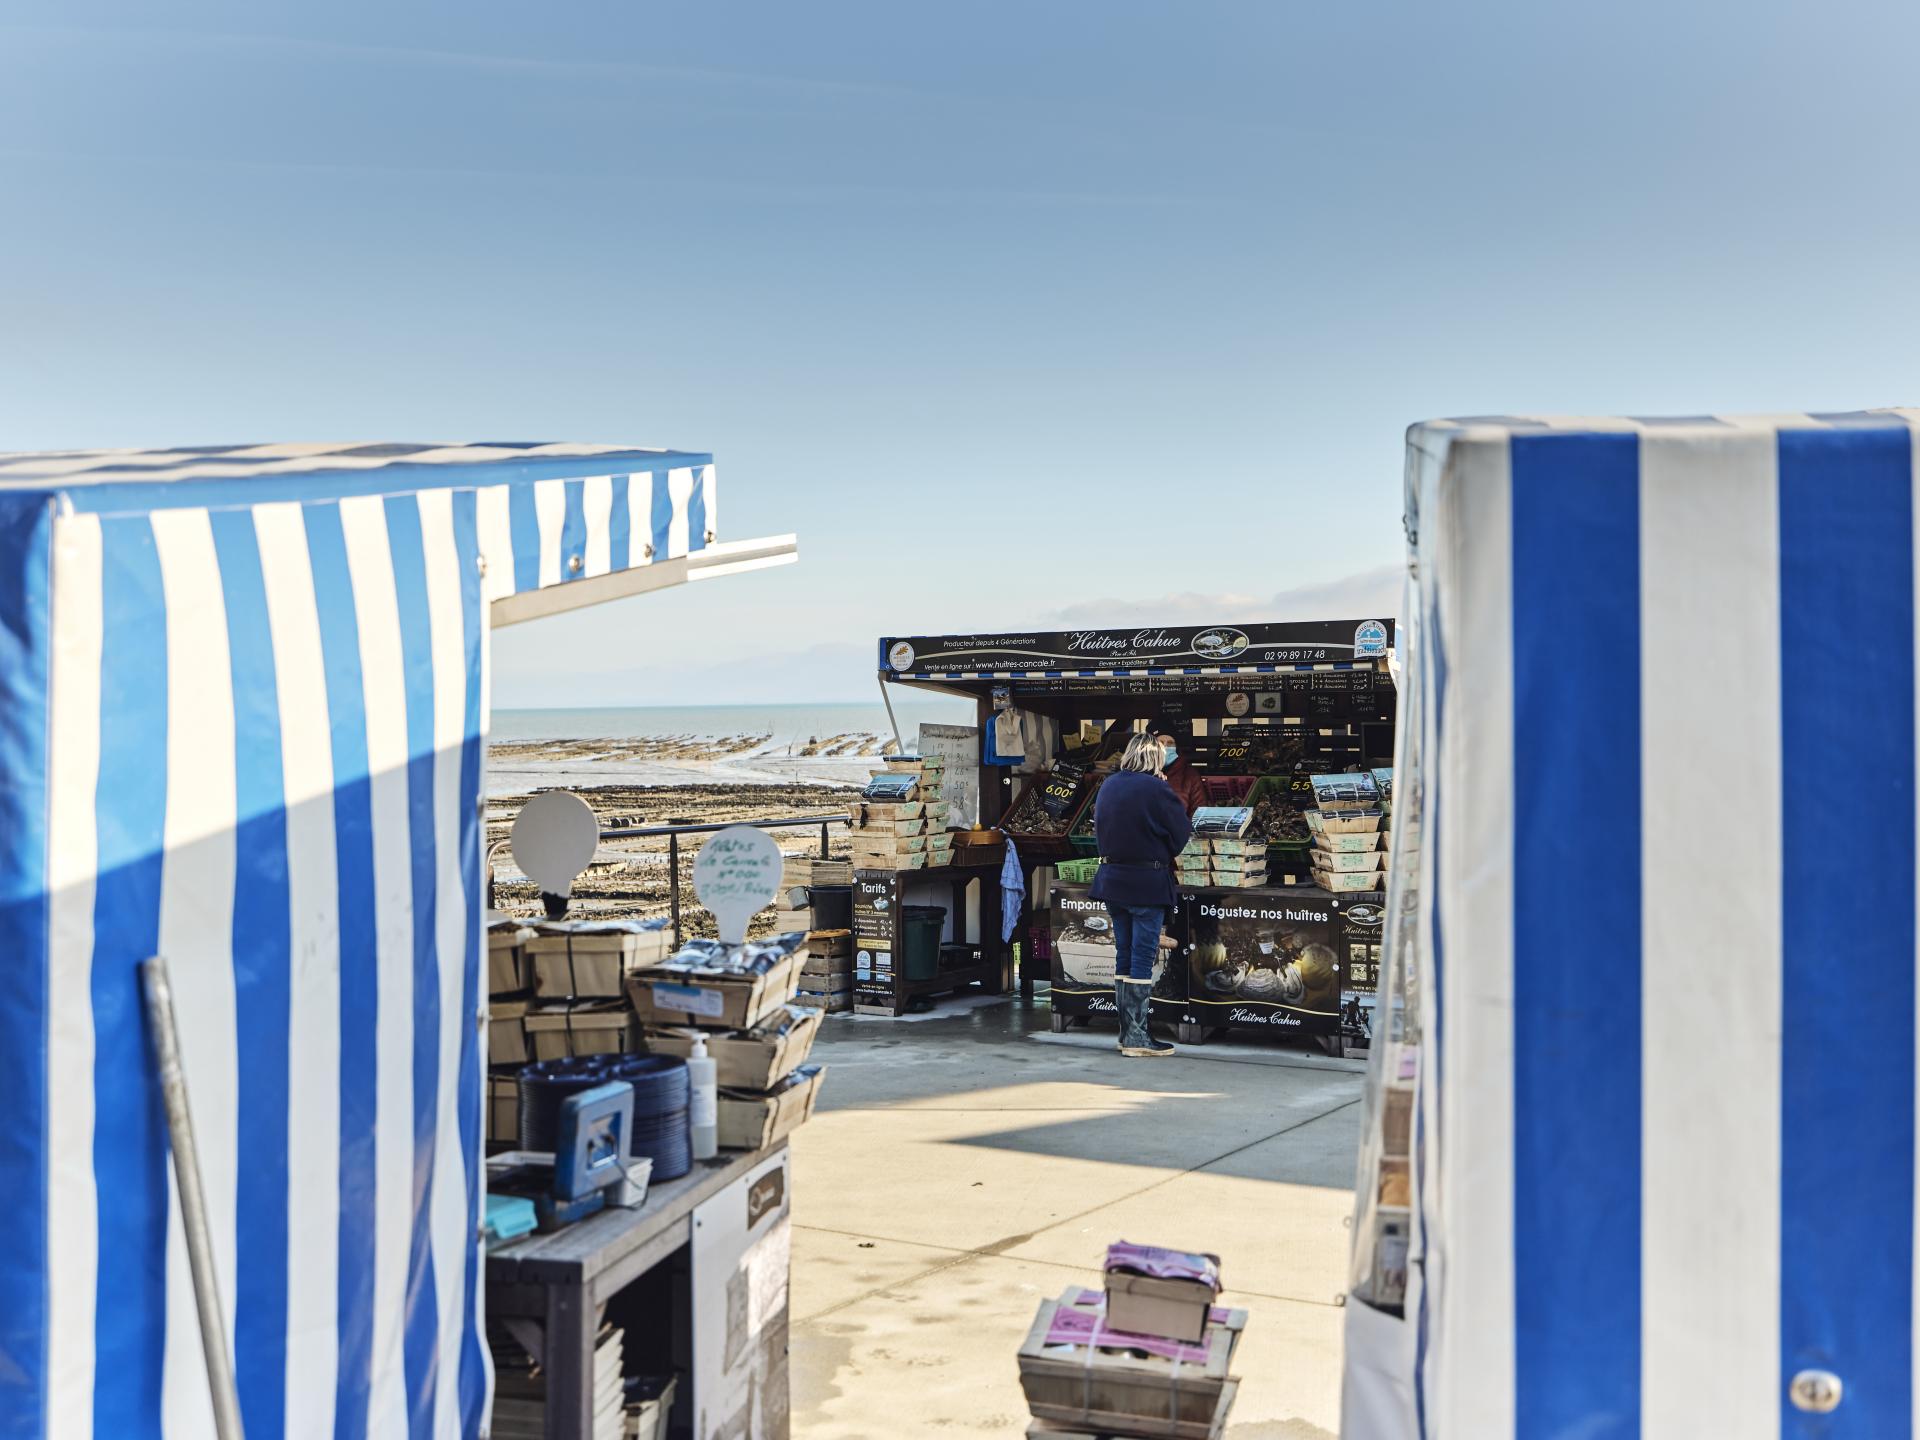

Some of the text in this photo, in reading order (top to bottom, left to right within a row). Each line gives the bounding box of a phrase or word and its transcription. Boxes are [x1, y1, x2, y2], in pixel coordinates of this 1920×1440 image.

[943, 640, 974, 648] Producteur
[975, 639, 995, 648] depuis
[1000, 638, 1036, 647] Générations
[1068, 629, 1181, 650] Huîtres Cahue
[1264, 650, 1325, 660] 02 99 89 17 48
[949, 663, 964, 672] ligne
[861, 883, 887, 894] Tarifs
[1060, 898, 1108, 912] Emporte
[1200, 904, 1329, 922] Dégustez nos huîtres
[1229, 1008, 1301, 1026] Huîtres Cahue
